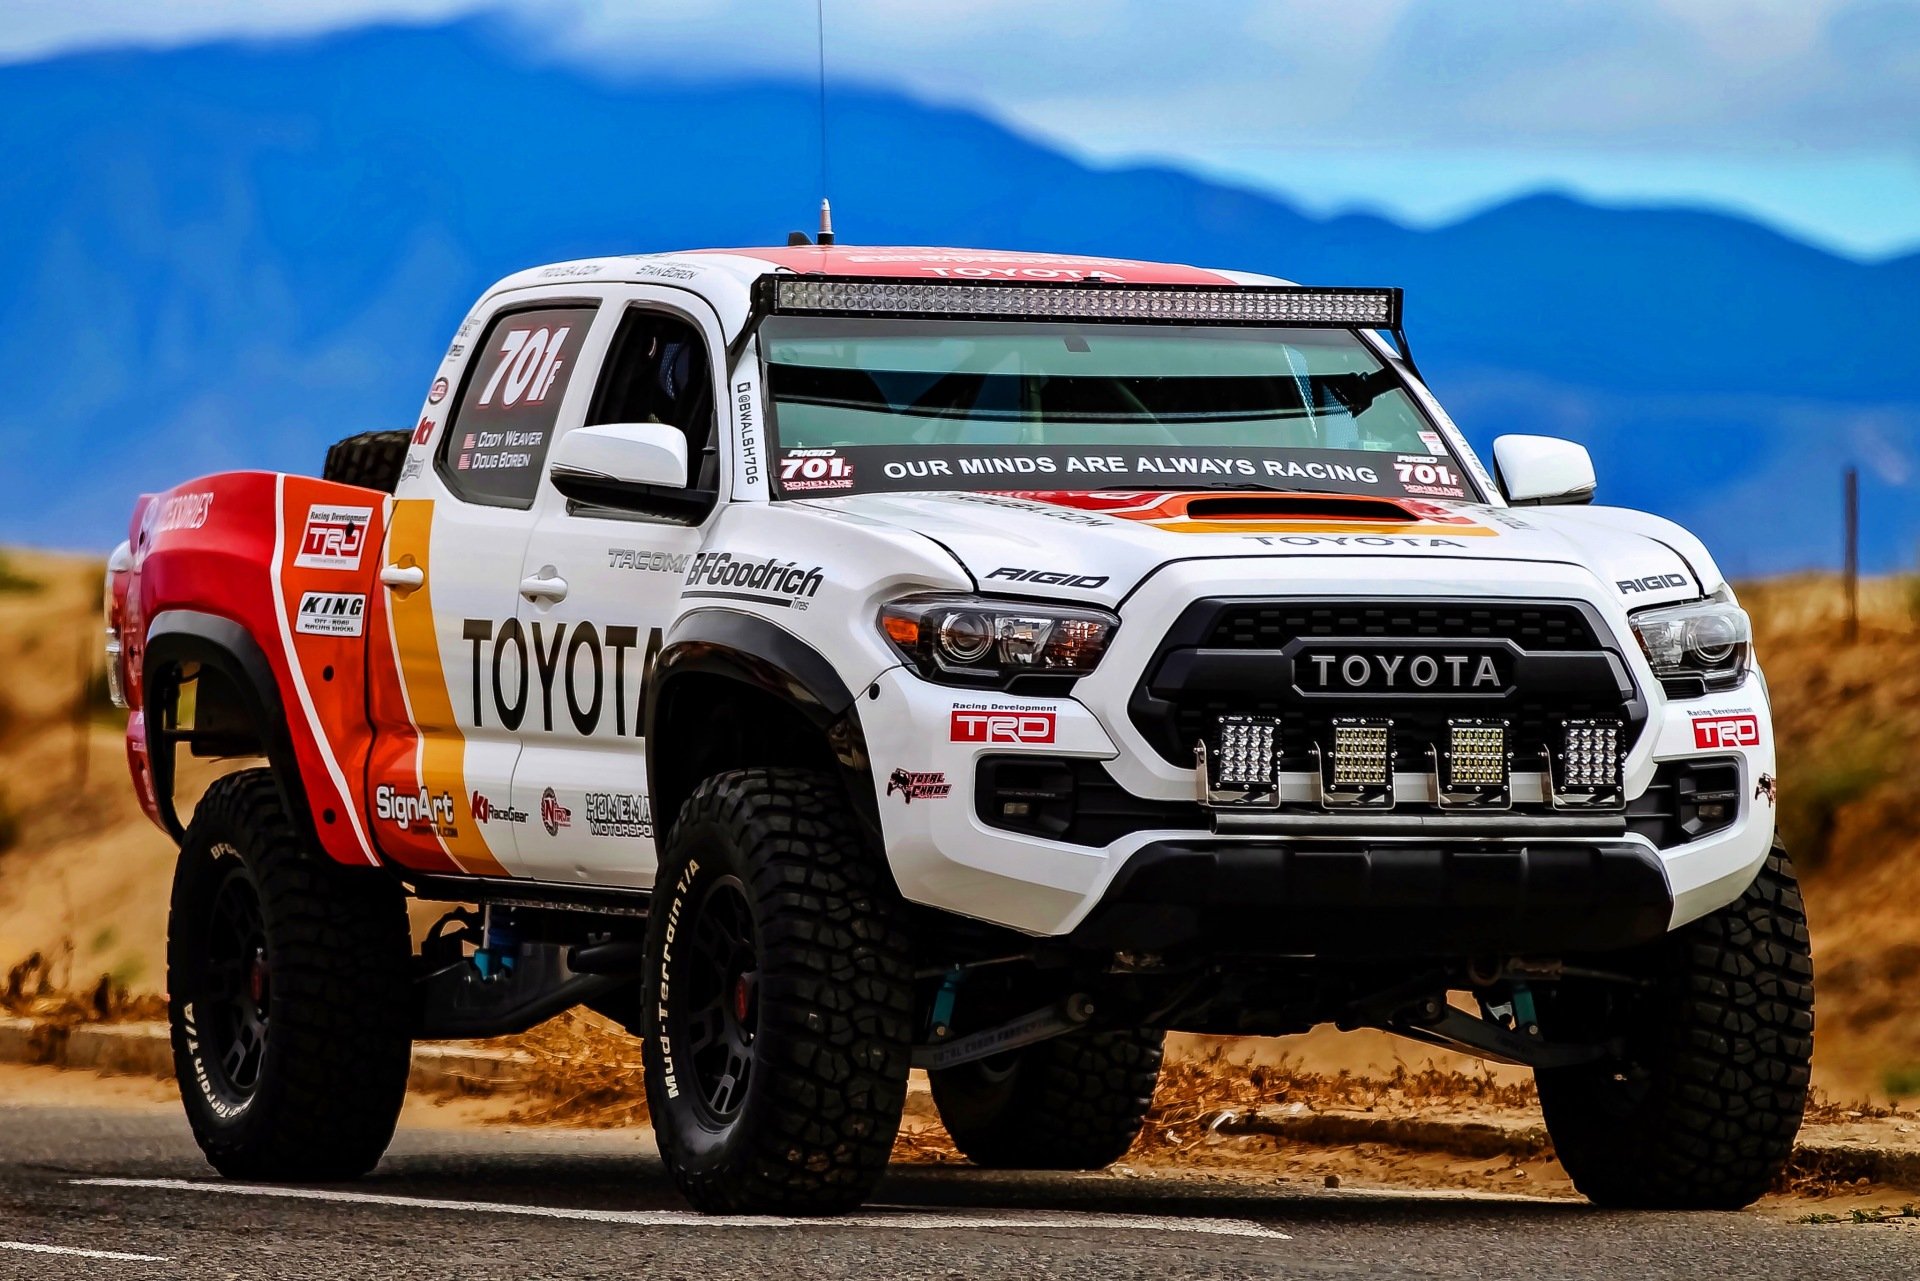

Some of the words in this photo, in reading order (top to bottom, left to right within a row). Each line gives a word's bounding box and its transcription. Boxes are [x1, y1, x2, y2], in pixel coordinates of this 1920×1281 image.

[921, 267, 1127, 281] TOYOTA
[478, 431, 505, 449] CODY
[506, 431, 543, 447] WEAVER
[472, 452, 499, 469] DOUG
[500, 453, 532, 468] BOREN
[788, 449, 837, 458] RIGID
[883, 460, 953, 479] OUR
[960, 456, 1057, 475] MINDS
[1065, 456, 1129, 474] ARE
[1136, 456, 1256, 476] ALWAYS
[1262, 460, 1380, 484] RACING
[310, 511, 330, 522] Racing
[309, 527, 361, 556] TRD
[1242, 536, 1468, 549] TOYOTA
[686, 552, 824, 598] BFGoodrich
[985, 568, 1109, 589] RIGID
[1615, 573, 1688, 594] RIGID
[302, 596, 363, 616] KING
[1311, 655, 1501, 687] TOYOTA
[952, 702, 987, 711] Racing
[991, 703, 1057, 713] Development
[1686, 709, 1711, 717] Racing
[1712, 707, 1754, 716] Development
[956, 715, 1049, 743] TRD
[1695, 721, 1756, 747] TRD
[376, 785, 453, 829] SignArt
[590, 823, 654, 838] MOTORSPO
[659, 897, 683, 1099] Mud-Terrain
[677, 859, 700, 895] T/A
